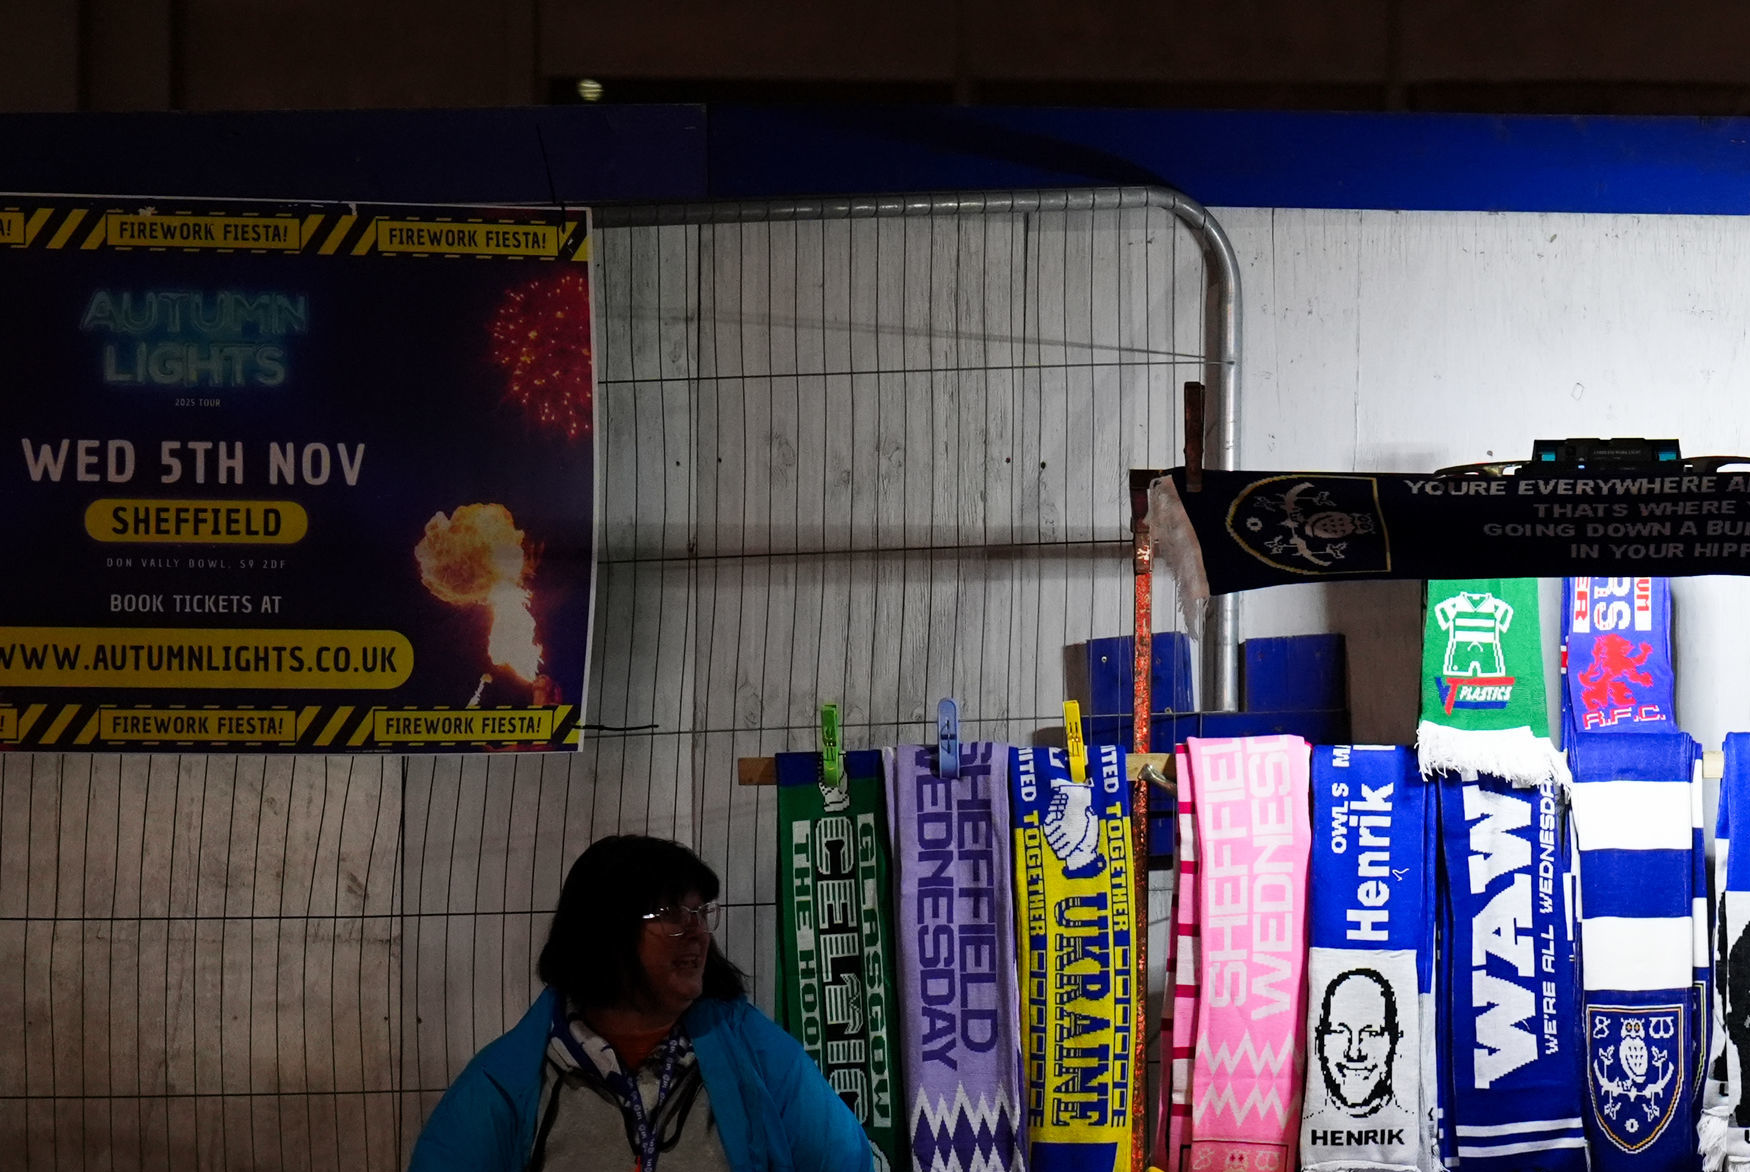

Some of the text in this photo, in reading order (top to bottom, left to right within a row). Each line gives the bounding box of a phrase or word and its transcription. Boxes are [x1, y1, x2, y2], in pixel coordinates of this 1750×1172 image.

[119, 222, 288, 242] FIREWORK FIESTA!
[389, 228, 546, 249] FIREWORK FIESTA!
[80, 290, 309, 335] AUTUMN
[103, 341, 287, 387] LIGHTS
[20, 437, 366, 486] WED 5TH NOV
[1403, 479, 1507, 496] YOURE
[1517, 476, 1718, 496] EVERYWHERE
[112, 507, 282, 536] SHEFFIELD
[1533, 503, 1629, 518] THATS
[1638, 500, 1736, 517] WHERE
[1482, 522, 1576, 538] GOING
[1586, 521, 1672, 537] DOWN
[1678, 522, 1699, 537] A
[106, 558, 133, 568] DON
[1569, 543, 1599, 559] IN
[1611, 542, 1684, 560] YOUR
[110, 594, 282, 614] BOOK TICKETS AT
[1459, 685, 1514, 702] PLASTICS
[112, 715, 283, 735] FIREWORK FIESTA!
[386, 716, 542, 735] FIREWORK FIESTA!
[1331, 782, 1349, 854] OWLS
[1023, 810, 1047, 936] TOGETHER
[1106, 801, 1130, 931] TOGETHER
[1346, 782, 1394, 941] Henrik
[794, 833, 814, 931] THE
[1541, 924, 1556, 973] ALL
[815, 815, 869, 1127] CELTIC
[859, 822, 891, 1121] GLASGOW
[1052, 892, 1111, 1128] UKRAINE
[1541, 981, 1559, 1055] WE'RE
[1311, 1128, 1405, 1147] HENRIK
